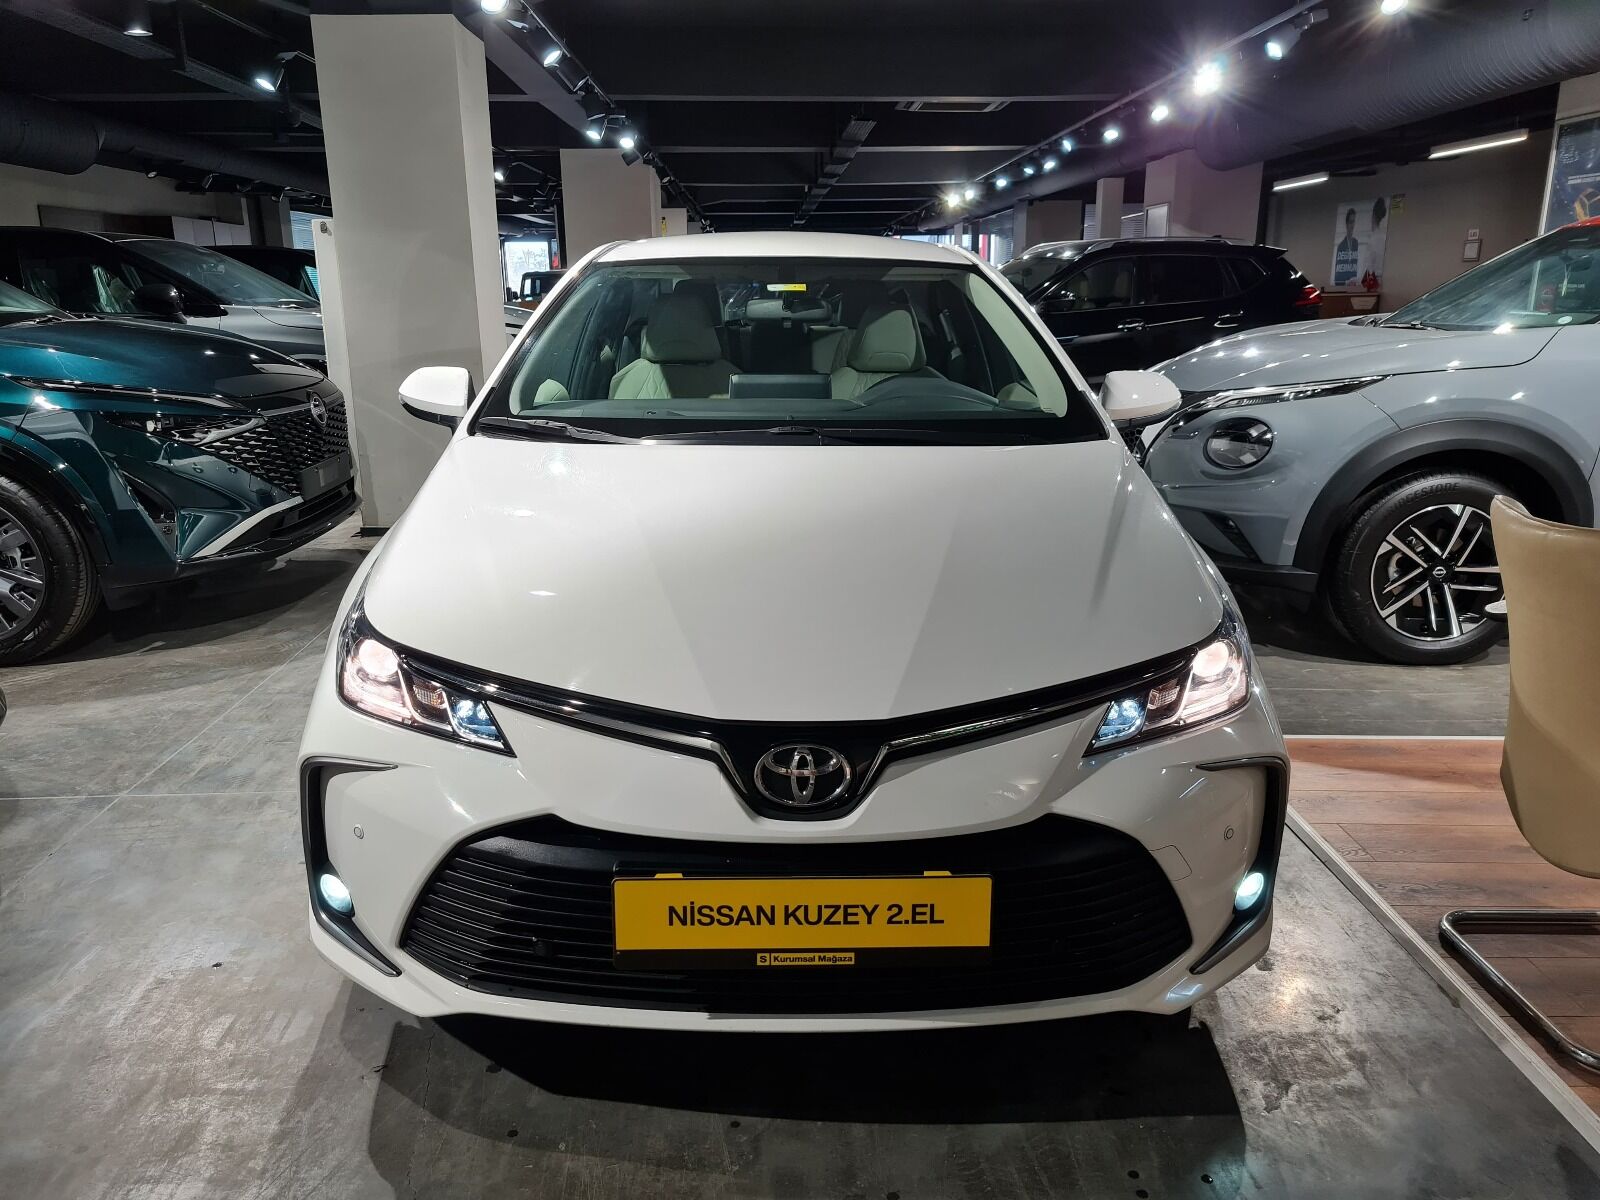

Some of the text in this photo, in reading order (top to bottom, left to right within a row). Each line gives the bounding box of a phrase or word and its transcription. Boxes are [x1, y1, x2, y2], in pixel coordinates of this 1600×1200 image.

[668, 901, 945, 927] NİSSAN KUZEY 2.EL
[773, 954, 816, 963] Kurumsal
[818, 954, 853, 964] Mağaza
